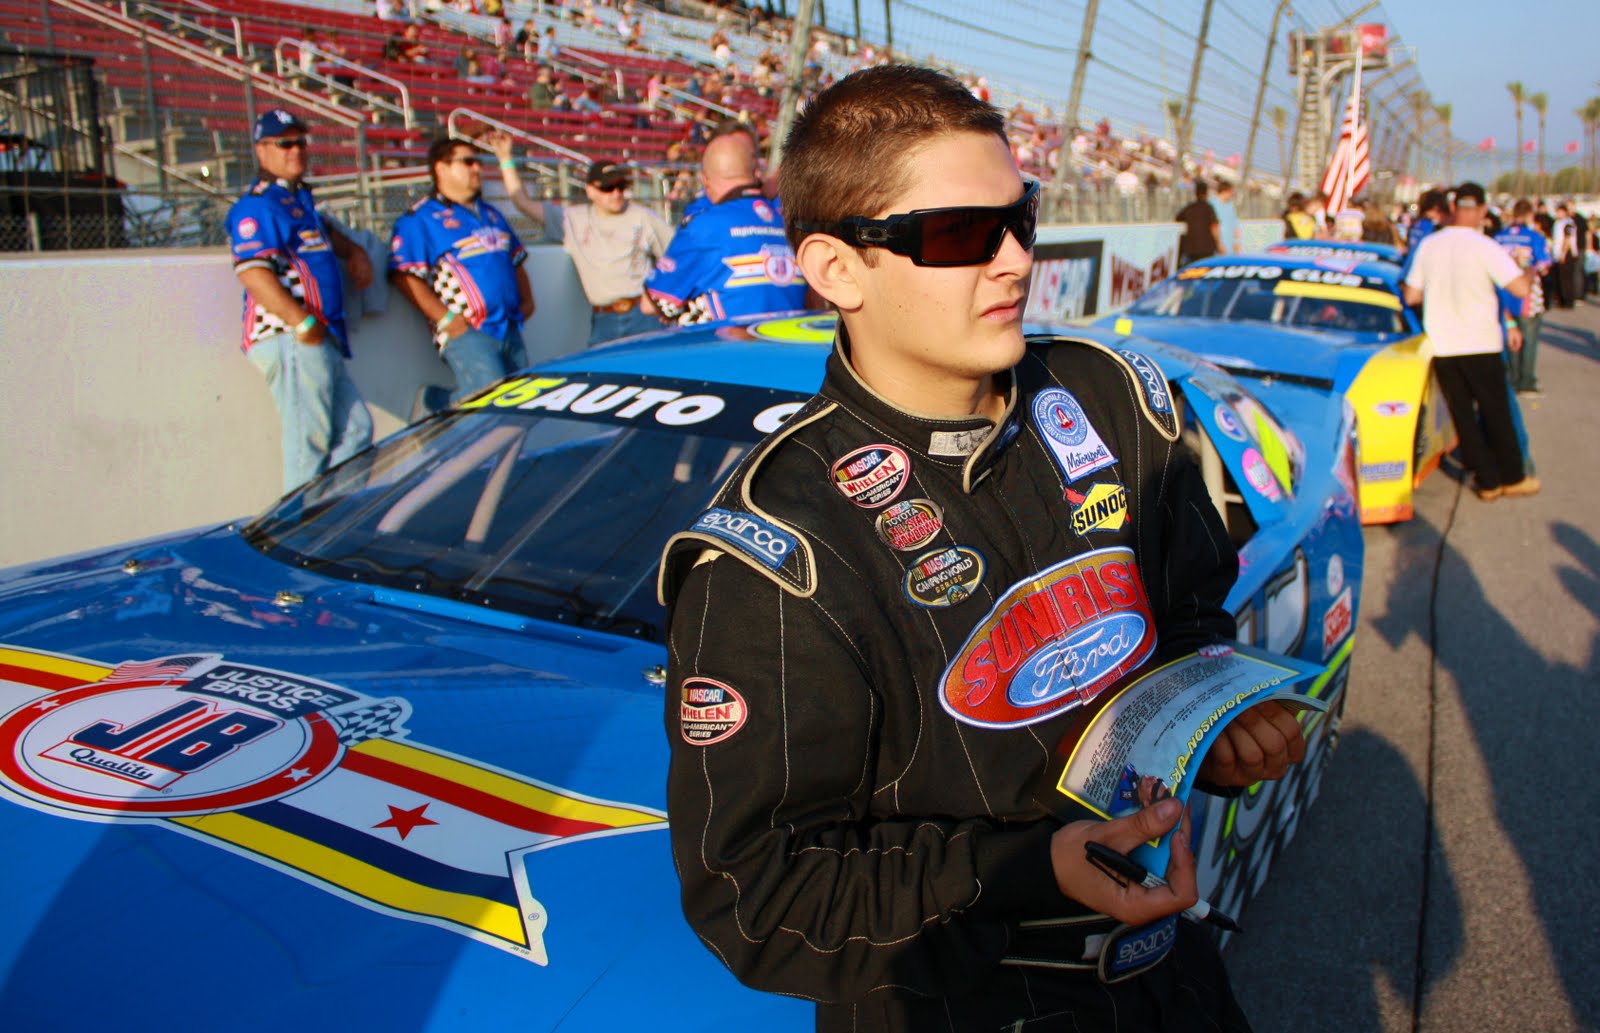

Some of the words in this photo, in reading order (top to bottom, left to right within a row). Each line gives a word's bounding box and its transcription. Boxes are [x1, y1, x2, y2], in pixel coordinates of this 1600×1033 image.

[1203, 265, 1283, 280] AUTO
[1290, 268, 1363, 287] CLUB
[517, 382, 726, 426] AUTO
[847, 451, 881, 477] NASCAR
[1065, 444, 1109, 474] Motorsports
[843, 461, 897, 494] WHELEN
[856, 475, 899, 501] ALL-AMERICAN
[886, 507, 919, 526] TOYOTA
[1075, 489, 1127, 531] SUNOC
[703, 512, 787, 555] sparco
[891, 517, 942, 549] SHOWDOWN
[915, 571, 948, 593] CAMPING
[946, 557, 973, 577] WORLD
[924, 549, 960, 576] NASCAR
[935, 575, 963, 593] SERIES
[1032, 623, 1130, 698] Ford
[202, 680, 300, 711] BROS.
[206, 670, 343, 707] JUSTICE
[689, 688, 723, 702] NASCAR
[682, 704, 731, 720] WHELEN
[73, 699, 279, 772] JB
[69, 747, 154, 781] Quality
